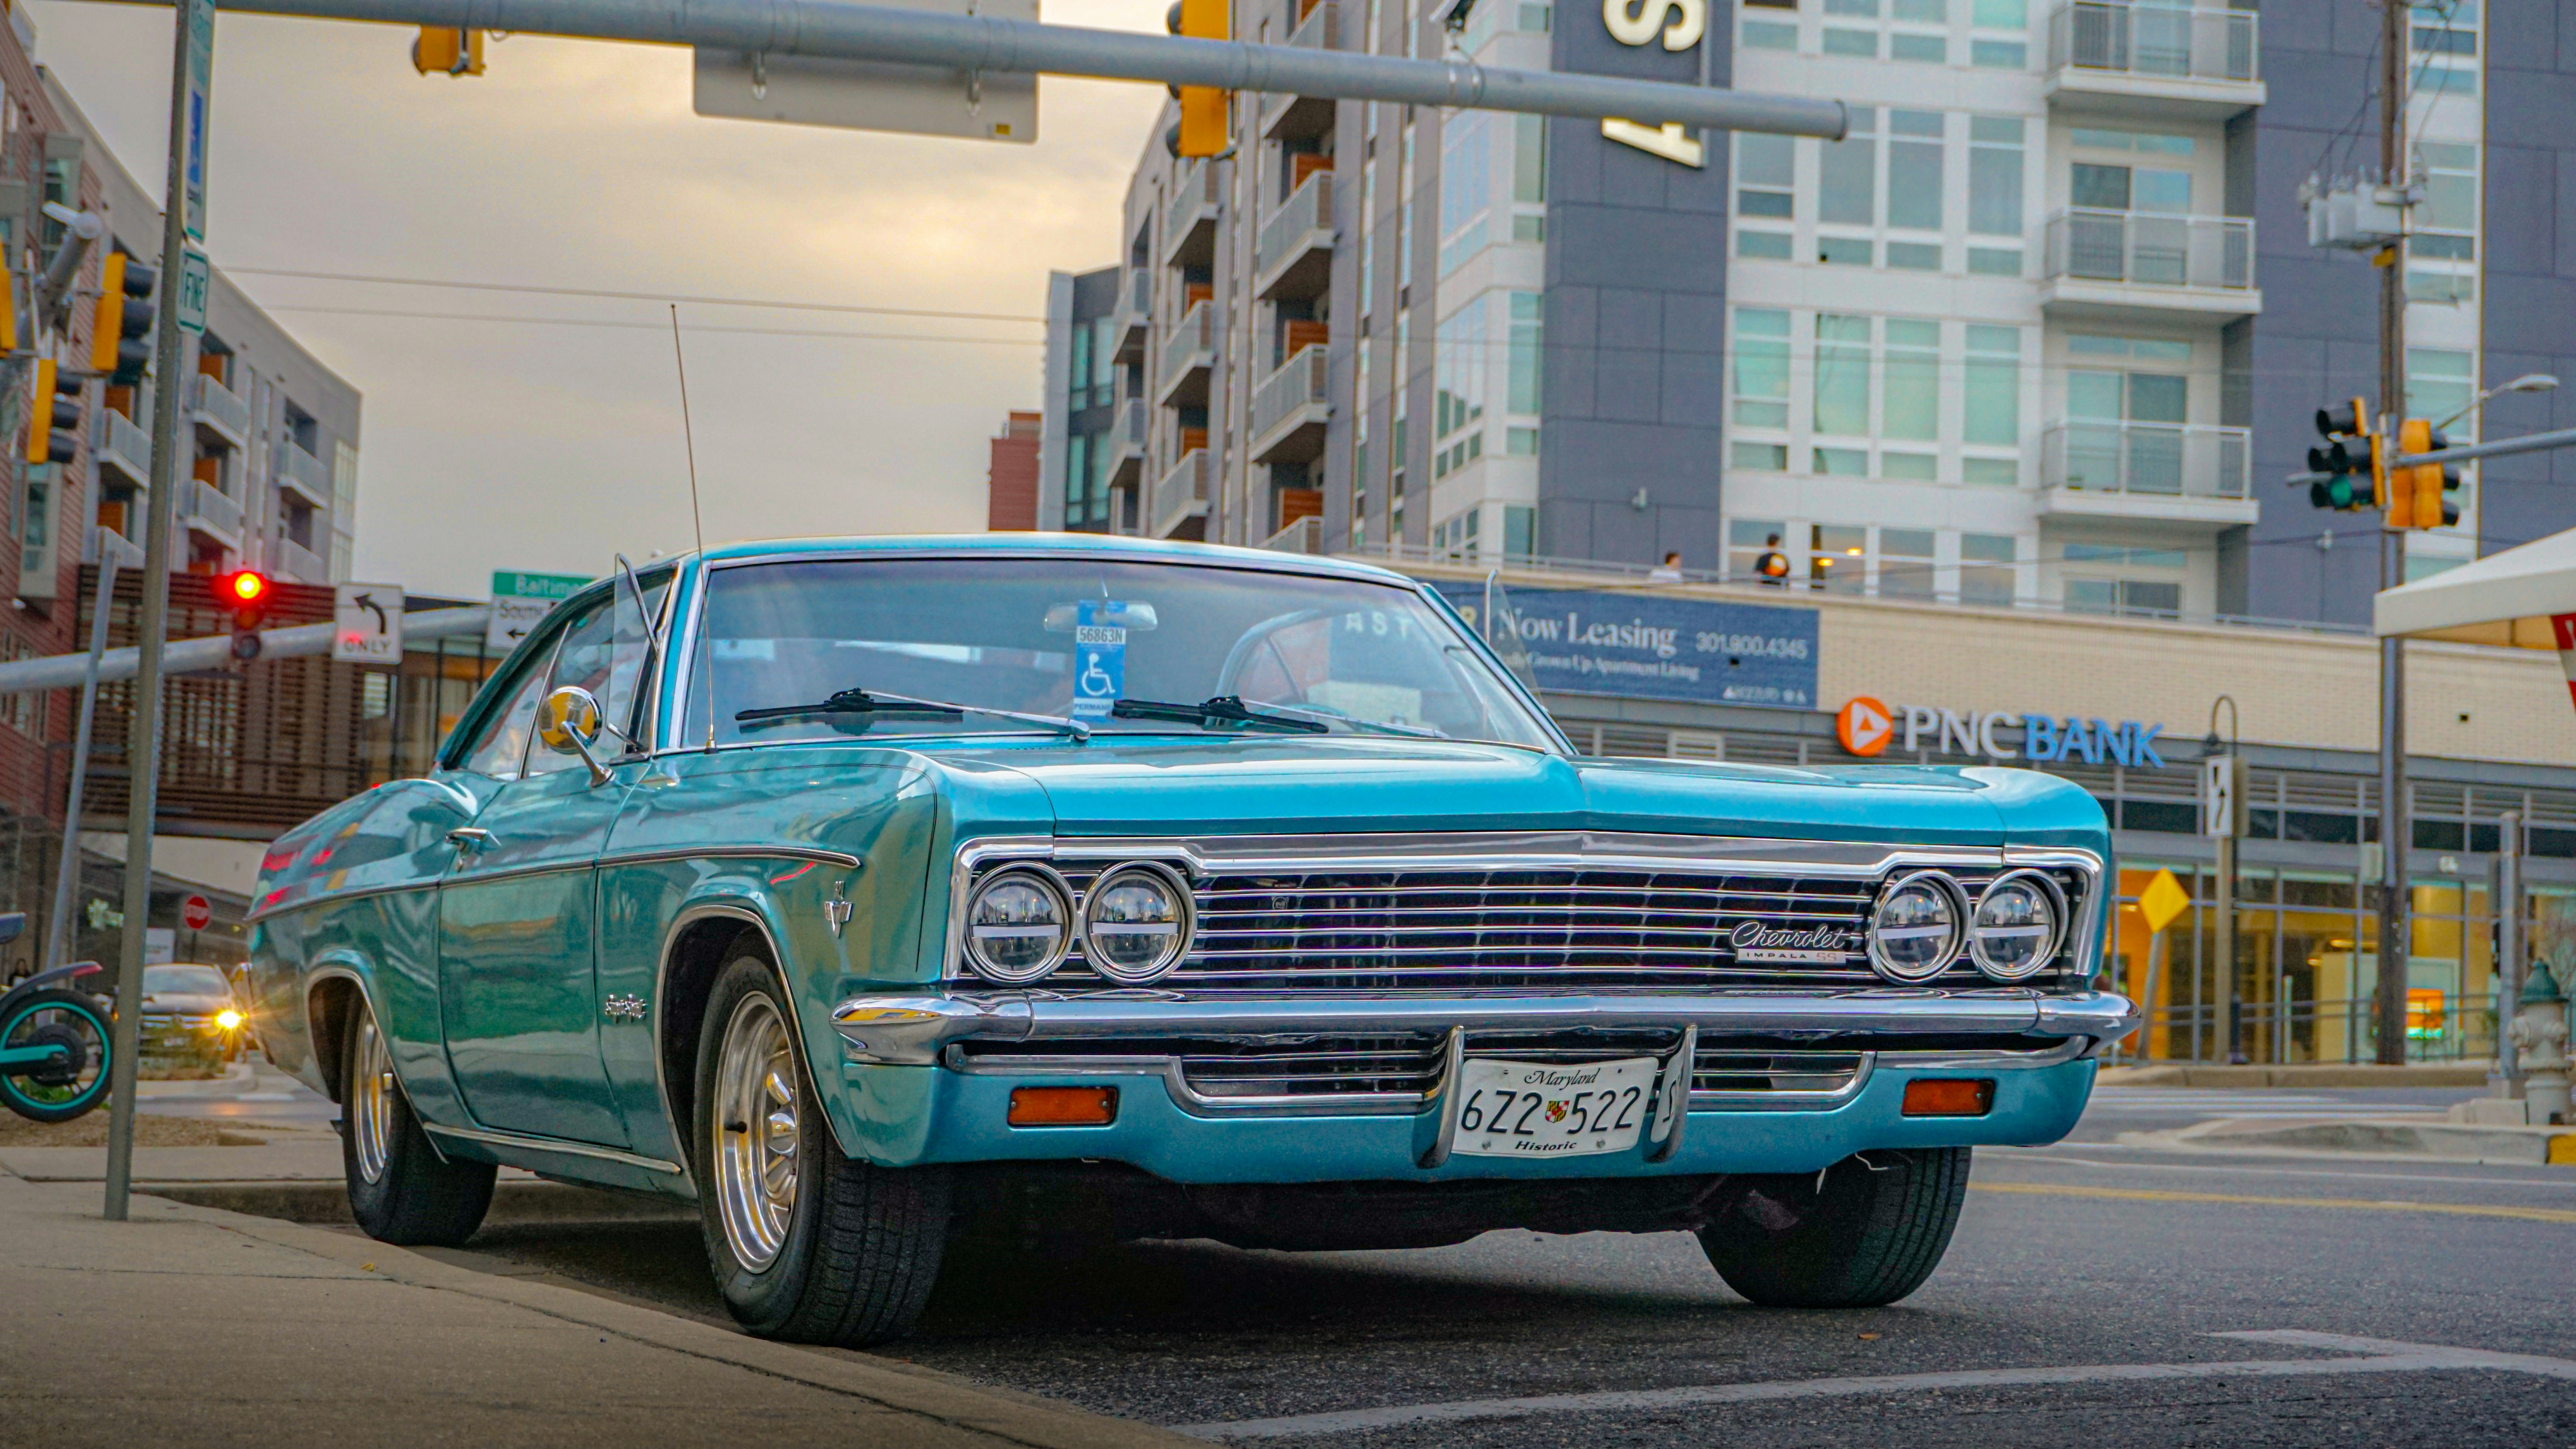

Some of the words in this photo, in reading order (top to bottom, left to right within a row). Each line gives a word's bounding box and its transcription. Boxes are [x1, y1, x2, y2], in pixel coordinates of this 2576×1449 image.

[185, 272, 204, 312] FINE
[516, 575, 581, 595] Baltimo
[1079, 627, 1123, 643] 56863N
[1498, 607, 1563, 642] Now
[1567, 612, 1677, 659] Leasing
[344, 637, 391, 654] ONLY
[1572, 654, 1593, 674] Up
[1596, 657, 1659, 676] Apartment
[1661, 660, 1700, 683] Living
[1900, 704, 2018, 758] PNC
[2021, 714, 2166, 768] BANK
[1732, 921, 1845, 949] Chevrolet
[1816, 952, 1837, 961] SS
[1524, 1068, 1601, 1091] Maryland
[1515, 1140, 1577, 1151] Historic
